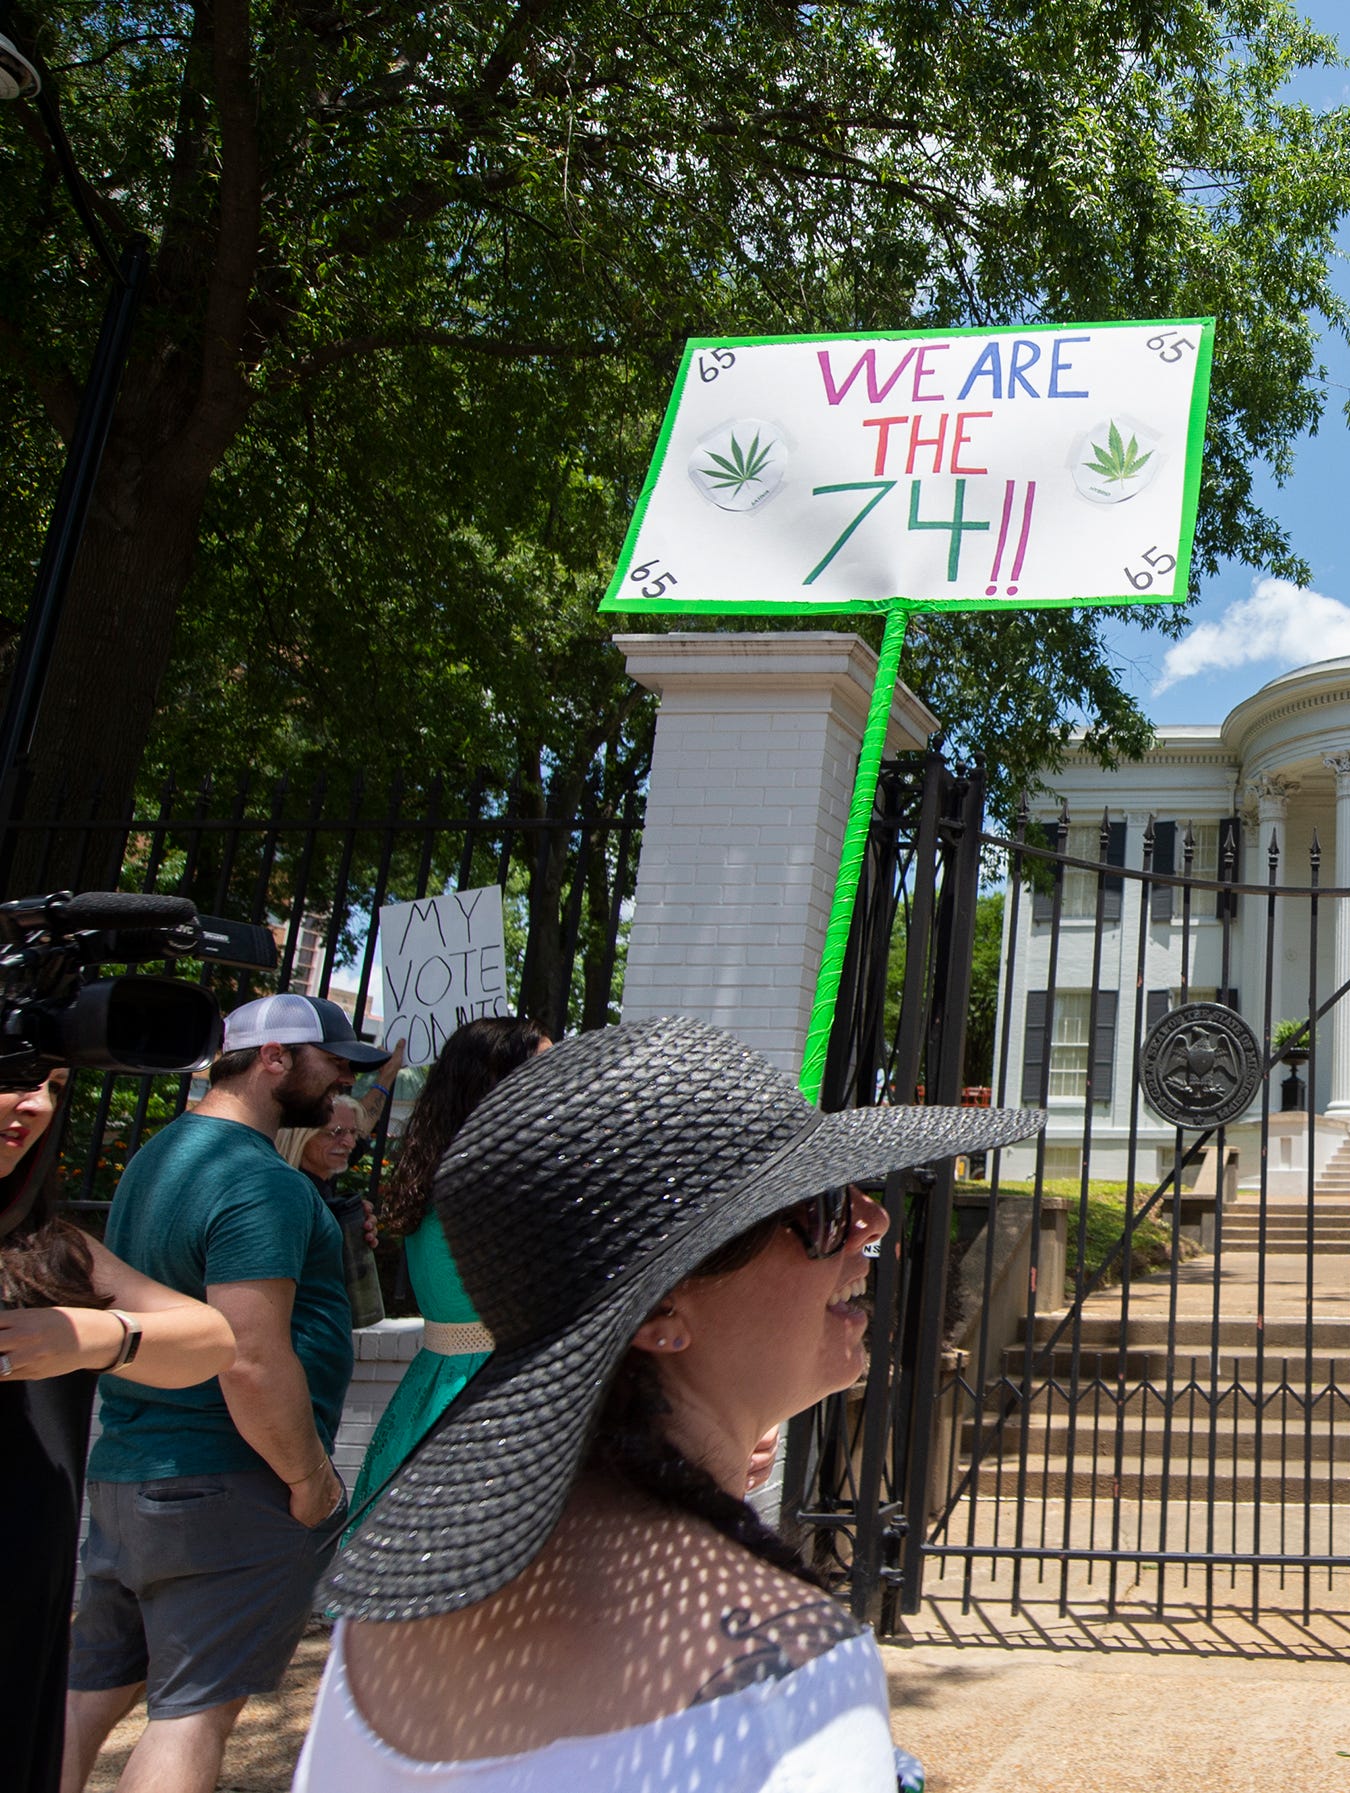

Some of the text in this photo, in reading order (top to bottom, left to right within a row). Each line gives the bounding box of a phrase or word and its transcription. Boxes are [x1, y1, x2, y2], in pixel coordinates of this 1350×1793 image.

[699, 347, 736, 384] 65
[817, 336, 1091, 406] WE ARE
[1147, 331, 1195, 364] 65
[863, 411, 993, 477] THE
[630, 560, 678, 599] 65
[1123, 546, 1177, 591] 65
[399, 890, 483, 956] MY
[385, 945, 501, 1012] VOTE
